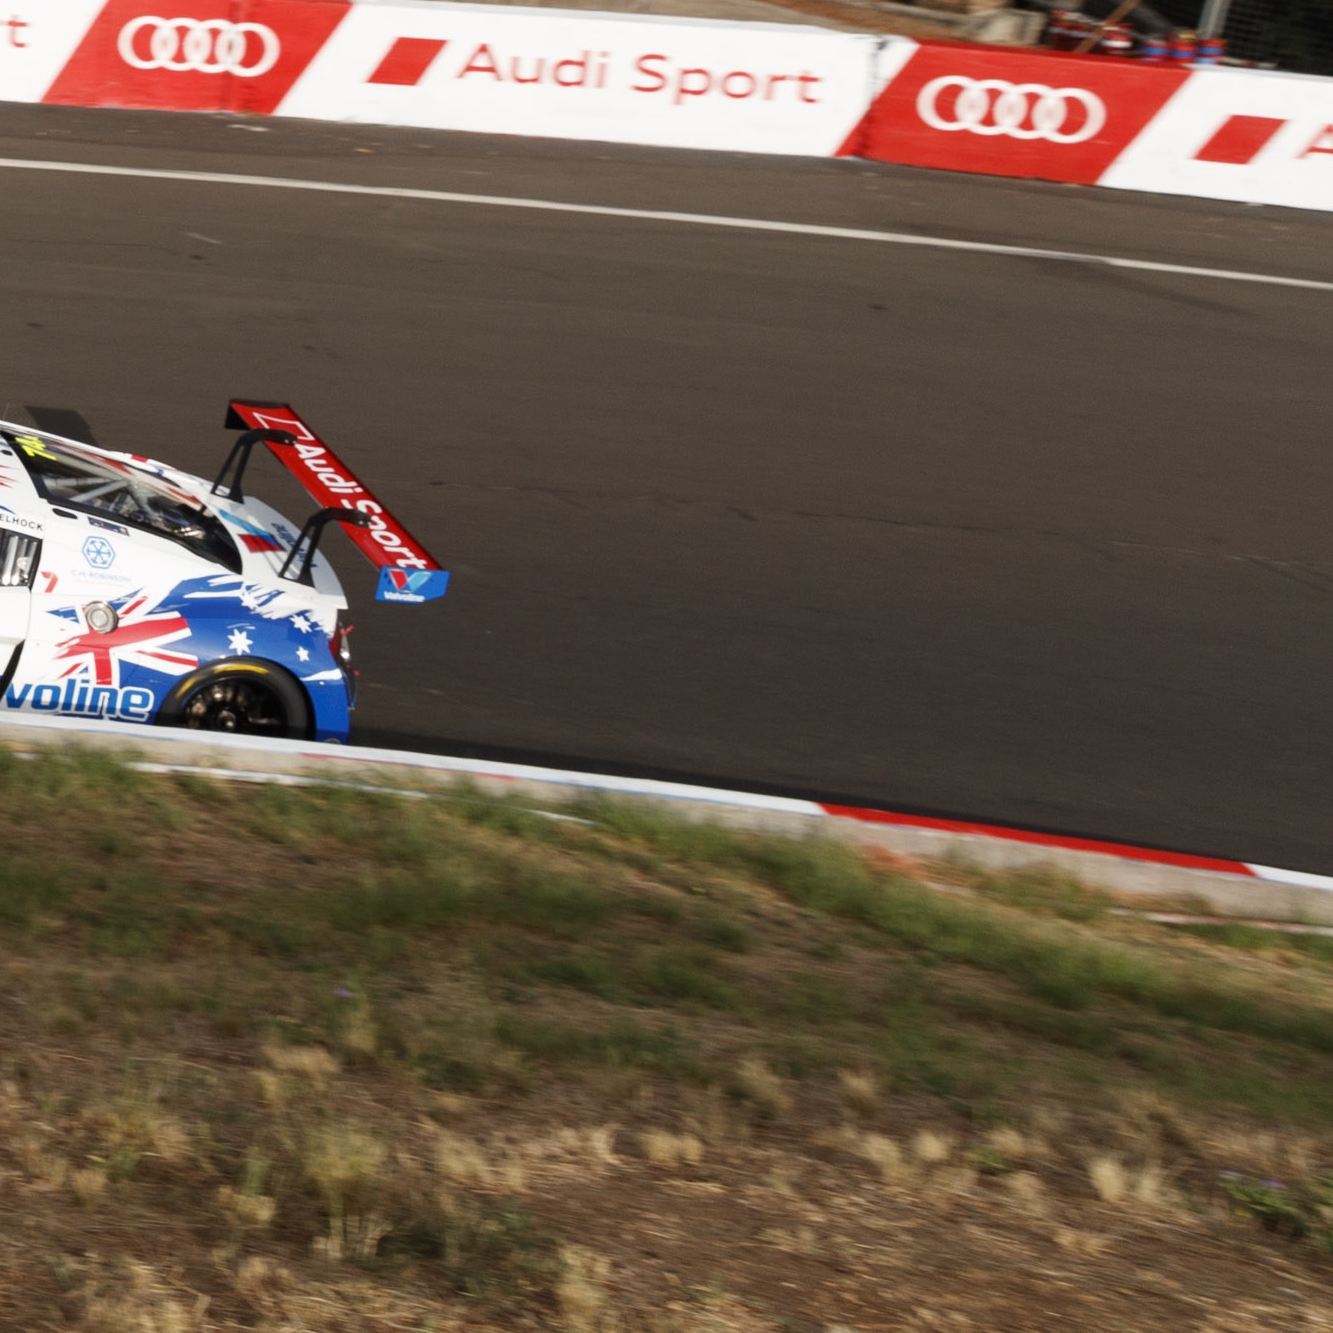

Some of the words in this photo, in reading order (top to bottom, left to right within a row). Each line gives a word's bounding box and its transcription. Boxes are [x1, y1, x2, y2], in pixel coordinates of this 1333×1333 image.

[454, 42, 612, 89] Audi
[629, 52, 826, 106] Sport
[294, 442, 364, 495] Audi
